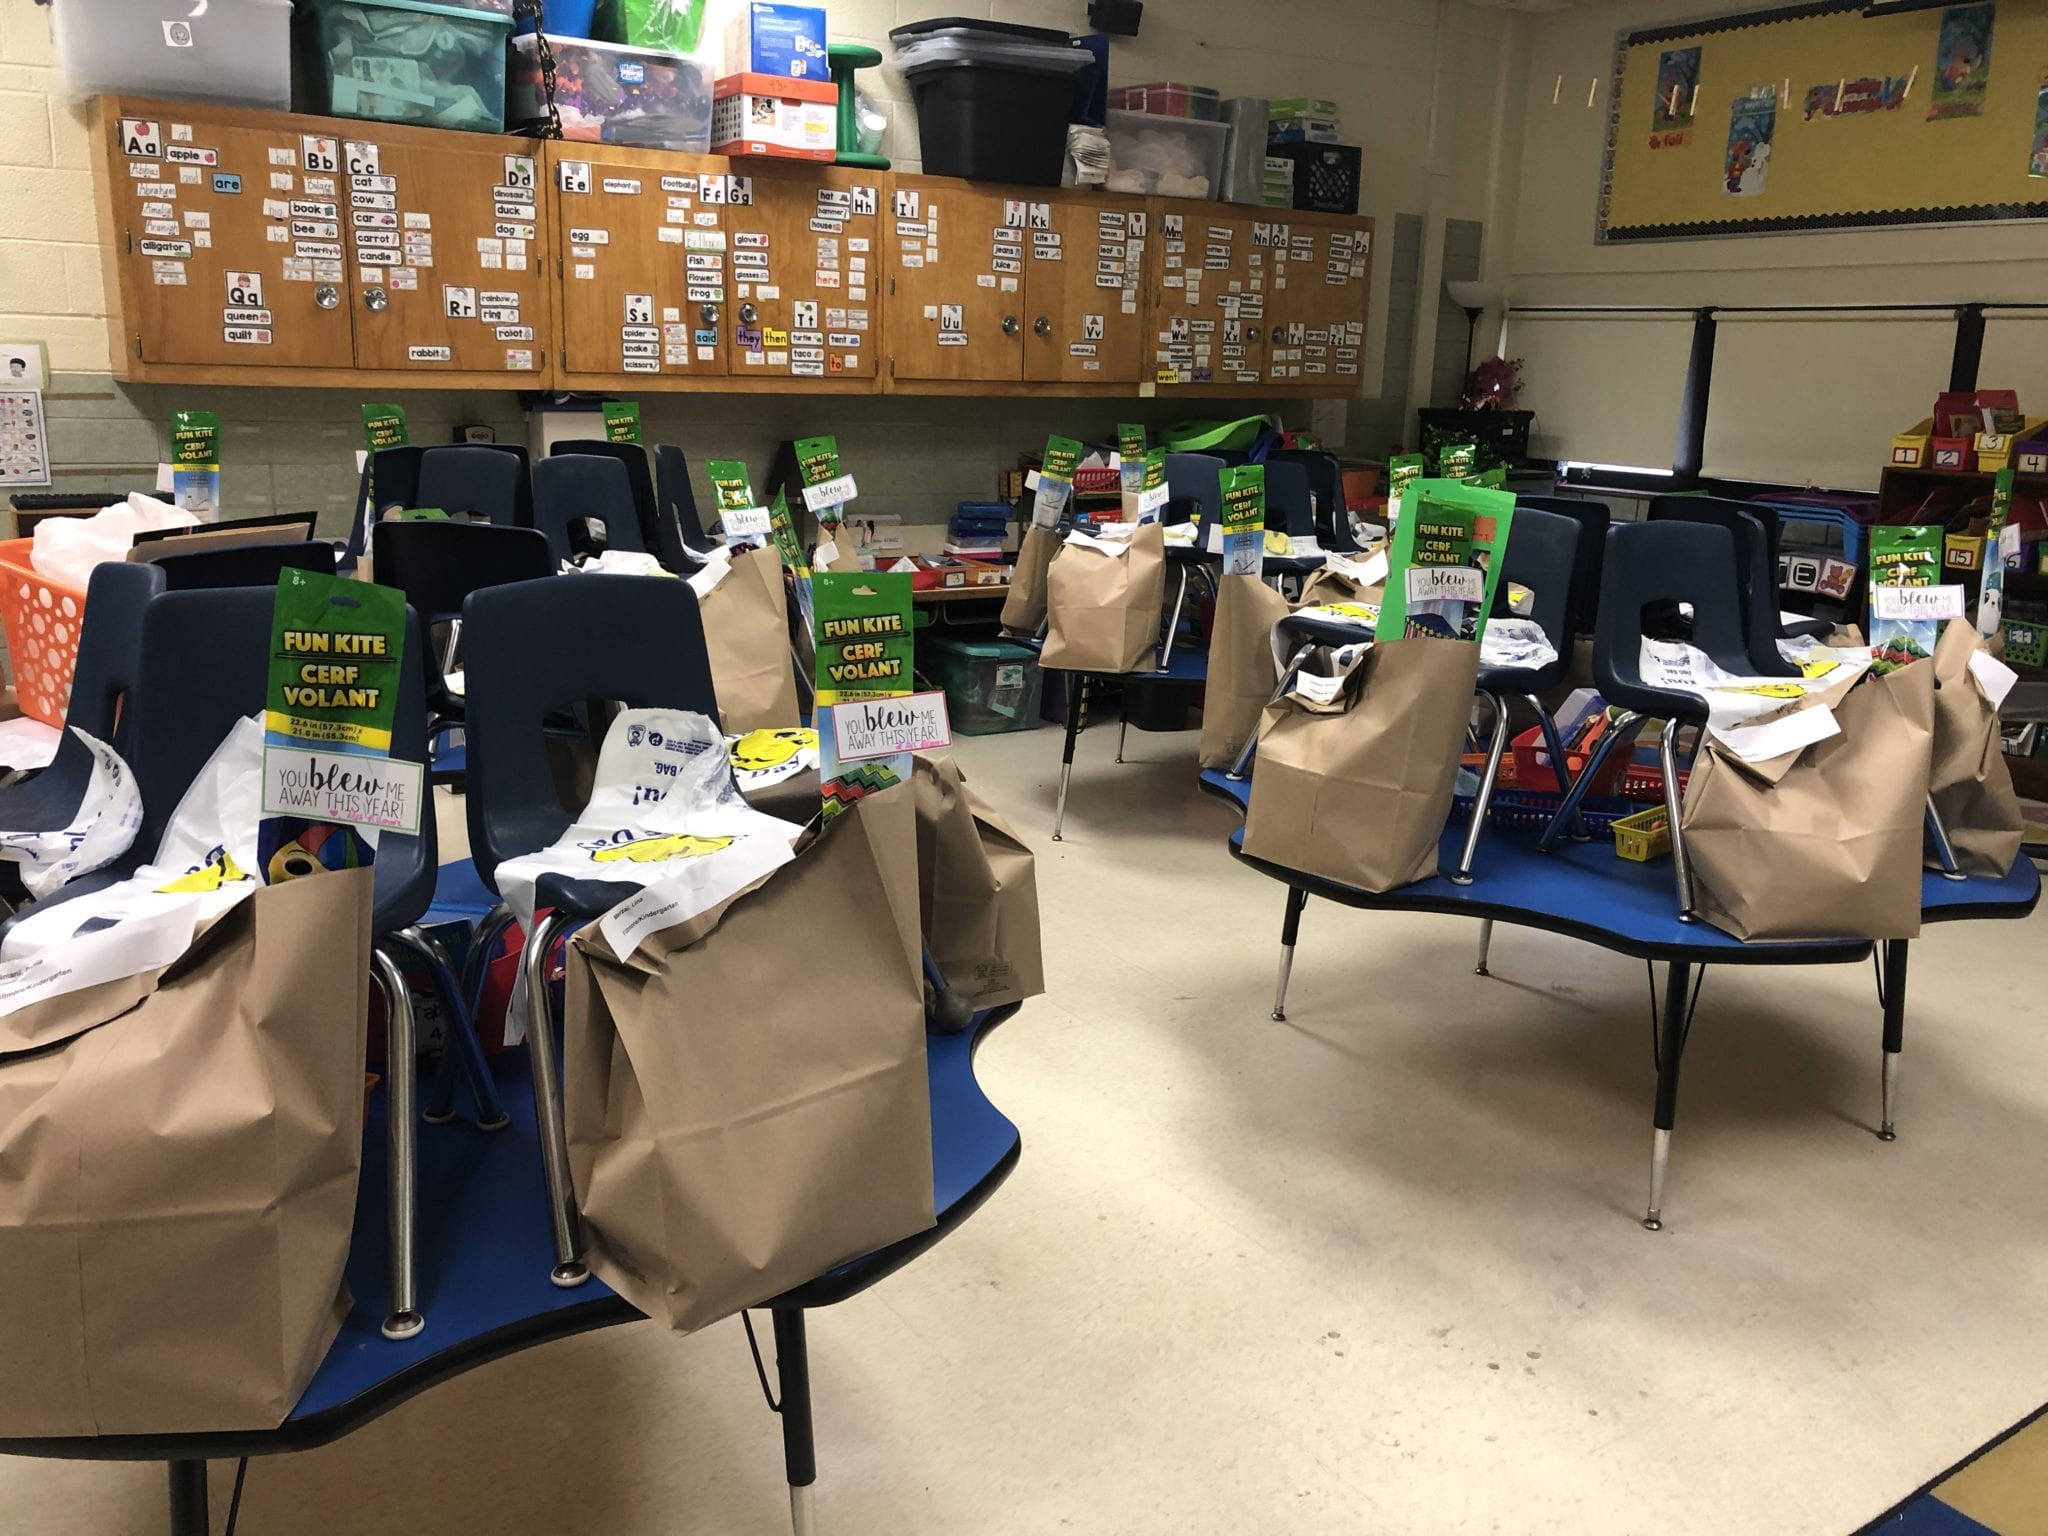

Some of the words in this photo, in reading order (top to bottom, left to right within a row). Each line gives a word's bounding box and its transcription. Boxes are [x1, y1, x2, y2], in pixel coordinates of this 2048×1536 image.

[170, 149, 200, 160] apple
[215, 179, 239, 190] are
[354, 178, 372, 187] cat
[605, 181, 631, 189] elephant
[663, 180, 691, 188] football
[495, 190, 524, 199] dinosaur
[820, 191, 833, 199] hat
[353, 196, 375, 204] cow
[294, 203, 321, 214] book
[497, 206, 520, 215] duck
[294, 224, 315, 234] bee
[497, 225, 515, 236] dog
[812, 222, 832, 230] house
[358, 234, 390, 243] carrot
[572, 232, 589, 241] egg
[995, 230, 1009, 238] jam
[1035, 235, 1048, 243] kite
[737, 235, 757, 244] glove
[143, 242, 184, 252] alligator
[298, 245, 333, 255] butterfly
[995, 247, 1013, 255] jeans
[360, 253, 391, 261] candle
[735, 254, 757, 262] grapes
[1036, 250, 1048, 258] key
[689, 257, 705, 265] fish
[995, 261, 1011, 269] juice
[689, 273, 714, 281] flower
[816, 272, 839, 285] here
[690, 289, 710, 298] frog
[227, 313, 258, 321] queen
[483, 310, 501, 319] ring
[228, 331, 252, 340] quilt
[624, 330, 646, 338] spider
[697, 332, 716, 343] said
[765, 332, 786, 343] then
[738, 331, 761, 348] they
[412, 349, 440, 358] rabbit
[794, 350, 811, 358] taco
[625, 361, 653, 369] scissors
[831, 355, 840, 369] to
[1159, 369, 1177, 381] went
[368, 421, 383, 429] FUN
[176, 431, 194, 440] FUN
[372, 436, 401, 445] VOLANT
[184, 442, 206, 450] CERF
[1986, 435, 1998, 449] 3
[179, 450, 212, 459] VOLANT
[802, 456, 816, 466] FUN
[817, 452, 832, 461] KITE
[1049, 450, 1062, 458] FUN
[1903, 450, 1907, 463] 1
[1942, 452, 1953, 465] 2
[1047, 464, 1072, 473] VOLANT
[2028, 456, 2039, 472] 4
[809, 471, 835, 483] VOLANT
[715, 479, 730, 487] FUN
[730, 479, 743, 487] KITE
[819, 485, 842, 497] blew
[1225, 491, 1242, 501] FUN
[1242, 486, 1259, 498] KITE
[1233, 501, 1252, 511] CERF
[736, 513, 758, 523] blew
[1227, 508, 1258, 522] VOLANT
[1419, 524, 1439, 534] FUN
[1441, 526, 1464, 536] KITE
[1426, 541, 1451, 551] CERF
[1418, 552, 1460, 563] VOLANT
[1876, 553, 1900, 564] FUN
[1955, 552, 1966, 564] 15
[1417, 577, 1431, 586] YOU
[1431, 569, 1467, 585] blew
[1796, 564, 1814, 584] E
[292, 576, 306, 586] 8+
[1417, 586, 1438, 595] AWAY
[1441, 587, 1458, 595] THIS
[1900, 589, 1937, 605] blew
[824, 618, 860, 637] FUN
[863, 615, 902, 633] KITE
[284, 632, 329, 653] FUN
[335, 634, 386, 655] KITE
[842, 642, 884, 660] CERF
[301, 664, 359, 685] CERF
[829, 660, 900, 682] VOLANT
[283, 686, 380, 709] VOLANT
[845, 718, 866, 735] YOU
[864, 705, 919, 733] blew
[921, 710, 936, 725] ME
[290, 718, 308, 728] 22.6
[308, 722, 318, 730] in
[318, 722, 357, 734] (57.3cm)
[292, 728, 310, 738] 21.8
[312, 730, 321, 738] in
[848, 732, 877, 750] AWAY
[880, 729, 906, 746] THIS
[907, 724, 938, 742] YEAR!
[654, 762, 677, 777] BAG.
[279, 769, 308, 788] YOU
[310, 757, 384, 796] blew
[386, 783, 404, 800] ME
[278, 787, 319, 809] AWAY
[326, 791, 360, 812] THIS
[364, 797, 404, 819] YEAR!
[430, 1027, 442, 1040] 4
